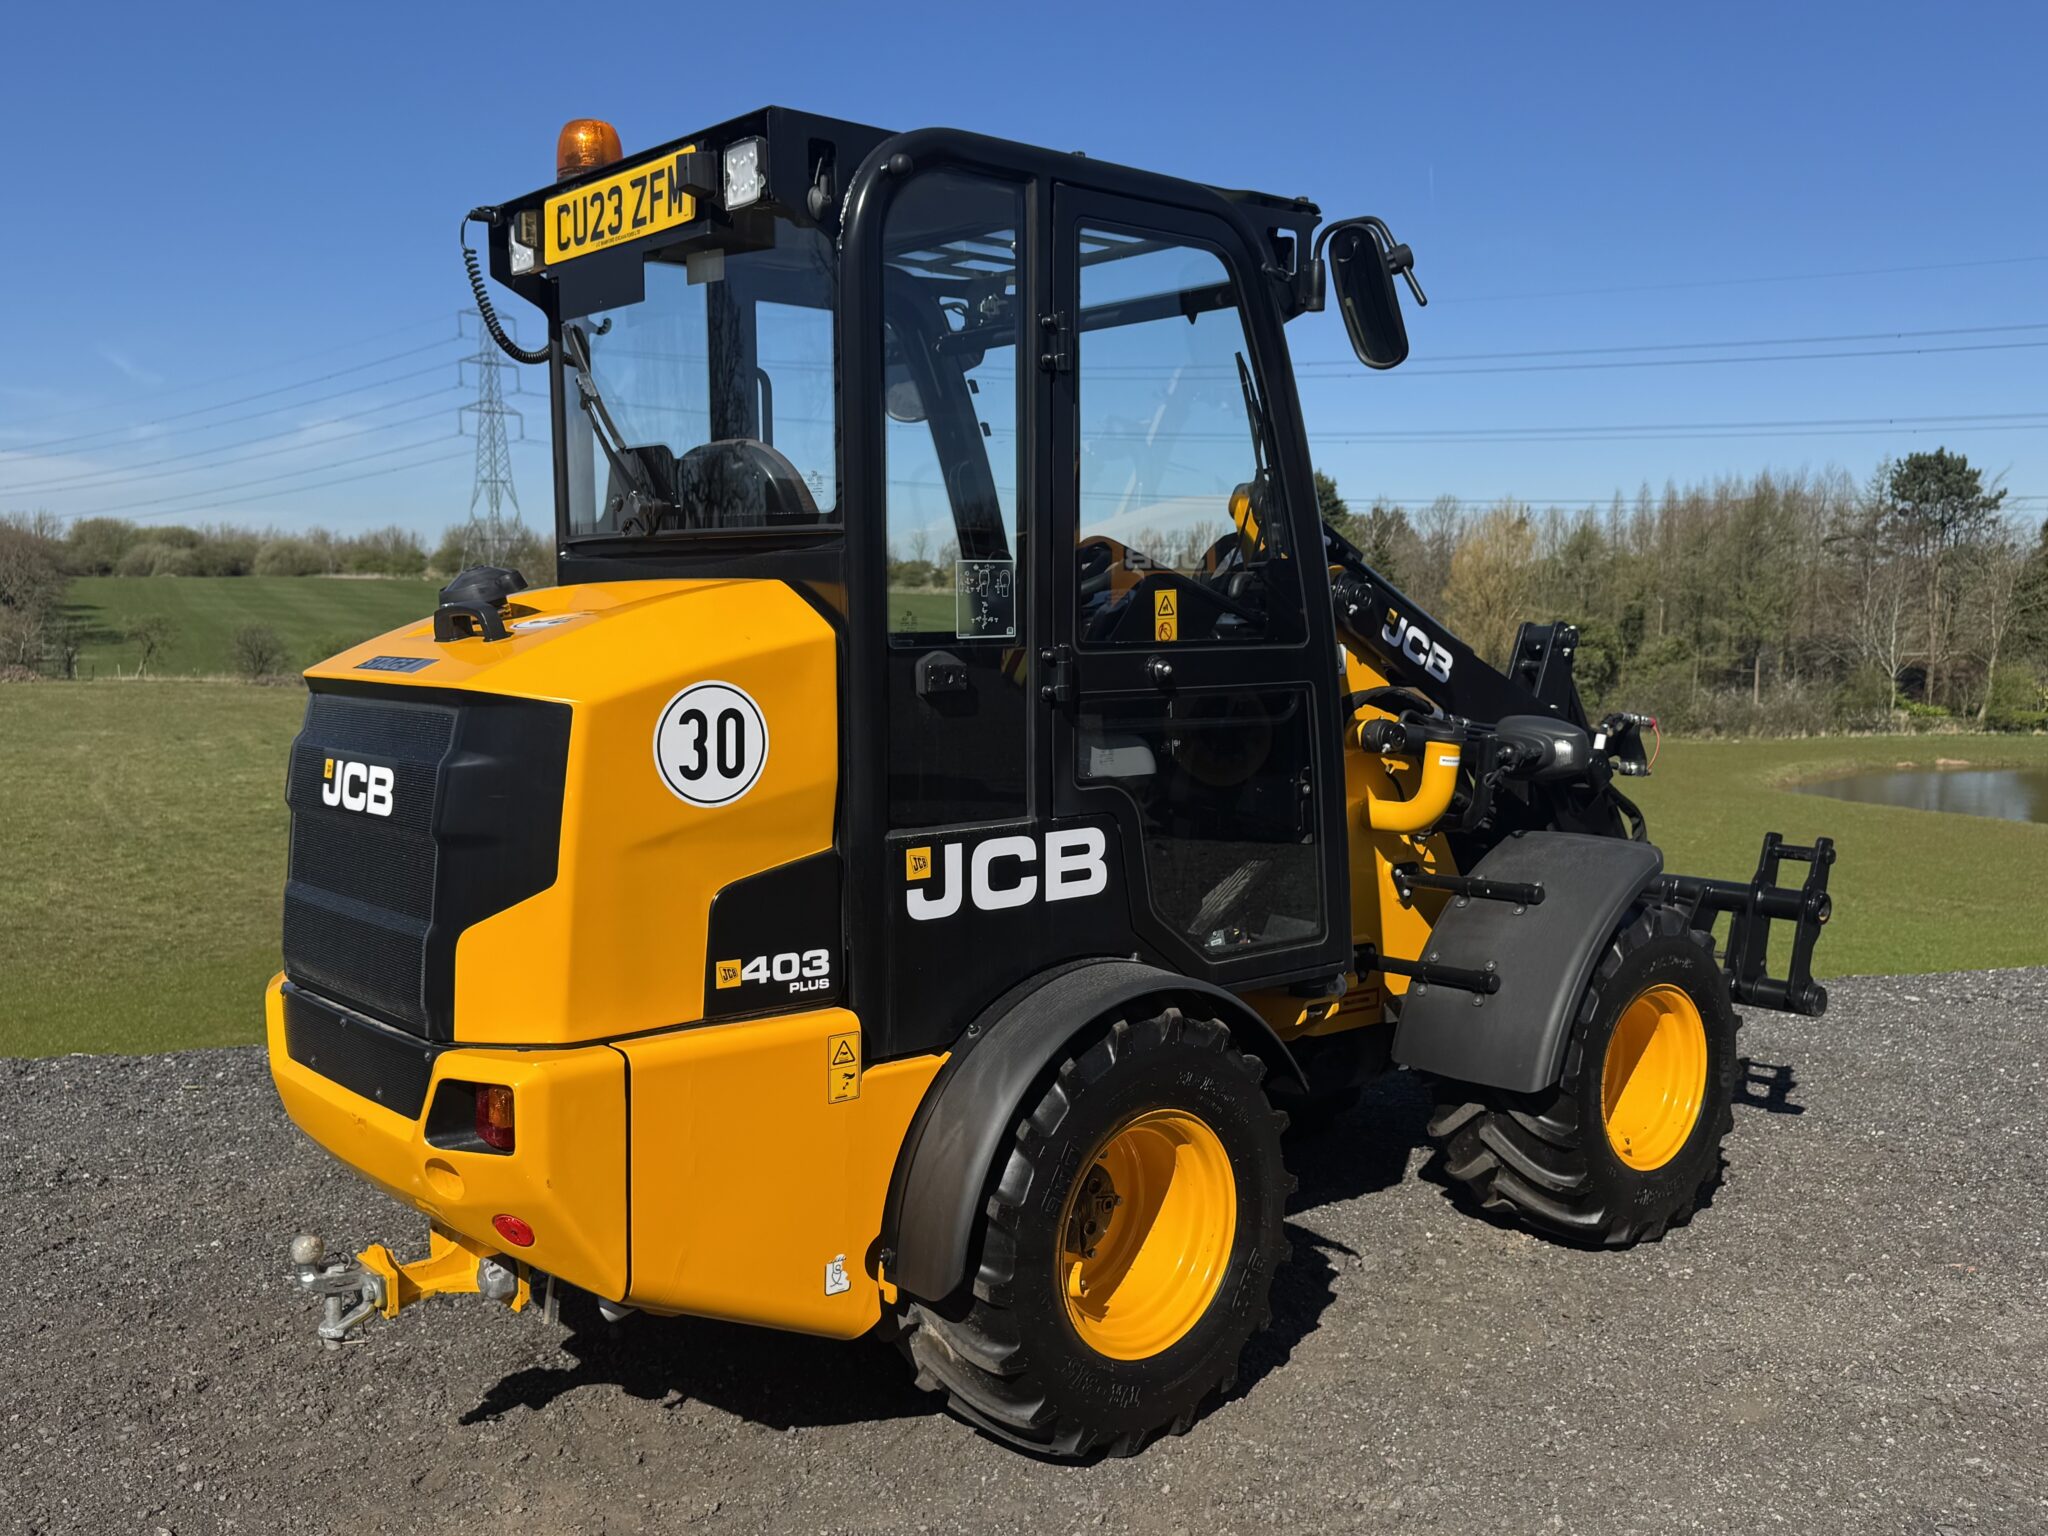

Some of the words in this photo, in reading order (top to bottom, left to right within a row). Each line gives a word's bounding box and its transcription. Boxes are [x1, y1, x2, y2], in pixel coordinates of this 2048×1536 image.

[557, 185, 622, 252] CU23
[629, 164, 683, 229] ZFM
[1382, 616, 1453, 683] JCB
[679, 708, 745, 781] 30
[322, 759, 394, 817] JCB
[906, 827, 1107, 921] JCB
[913, 856, 927, 872] JCB
[722, 967, 738, 981] JCB
[741, 948, 830, 984] 403
[789, 978, 830, 993] PLUS
